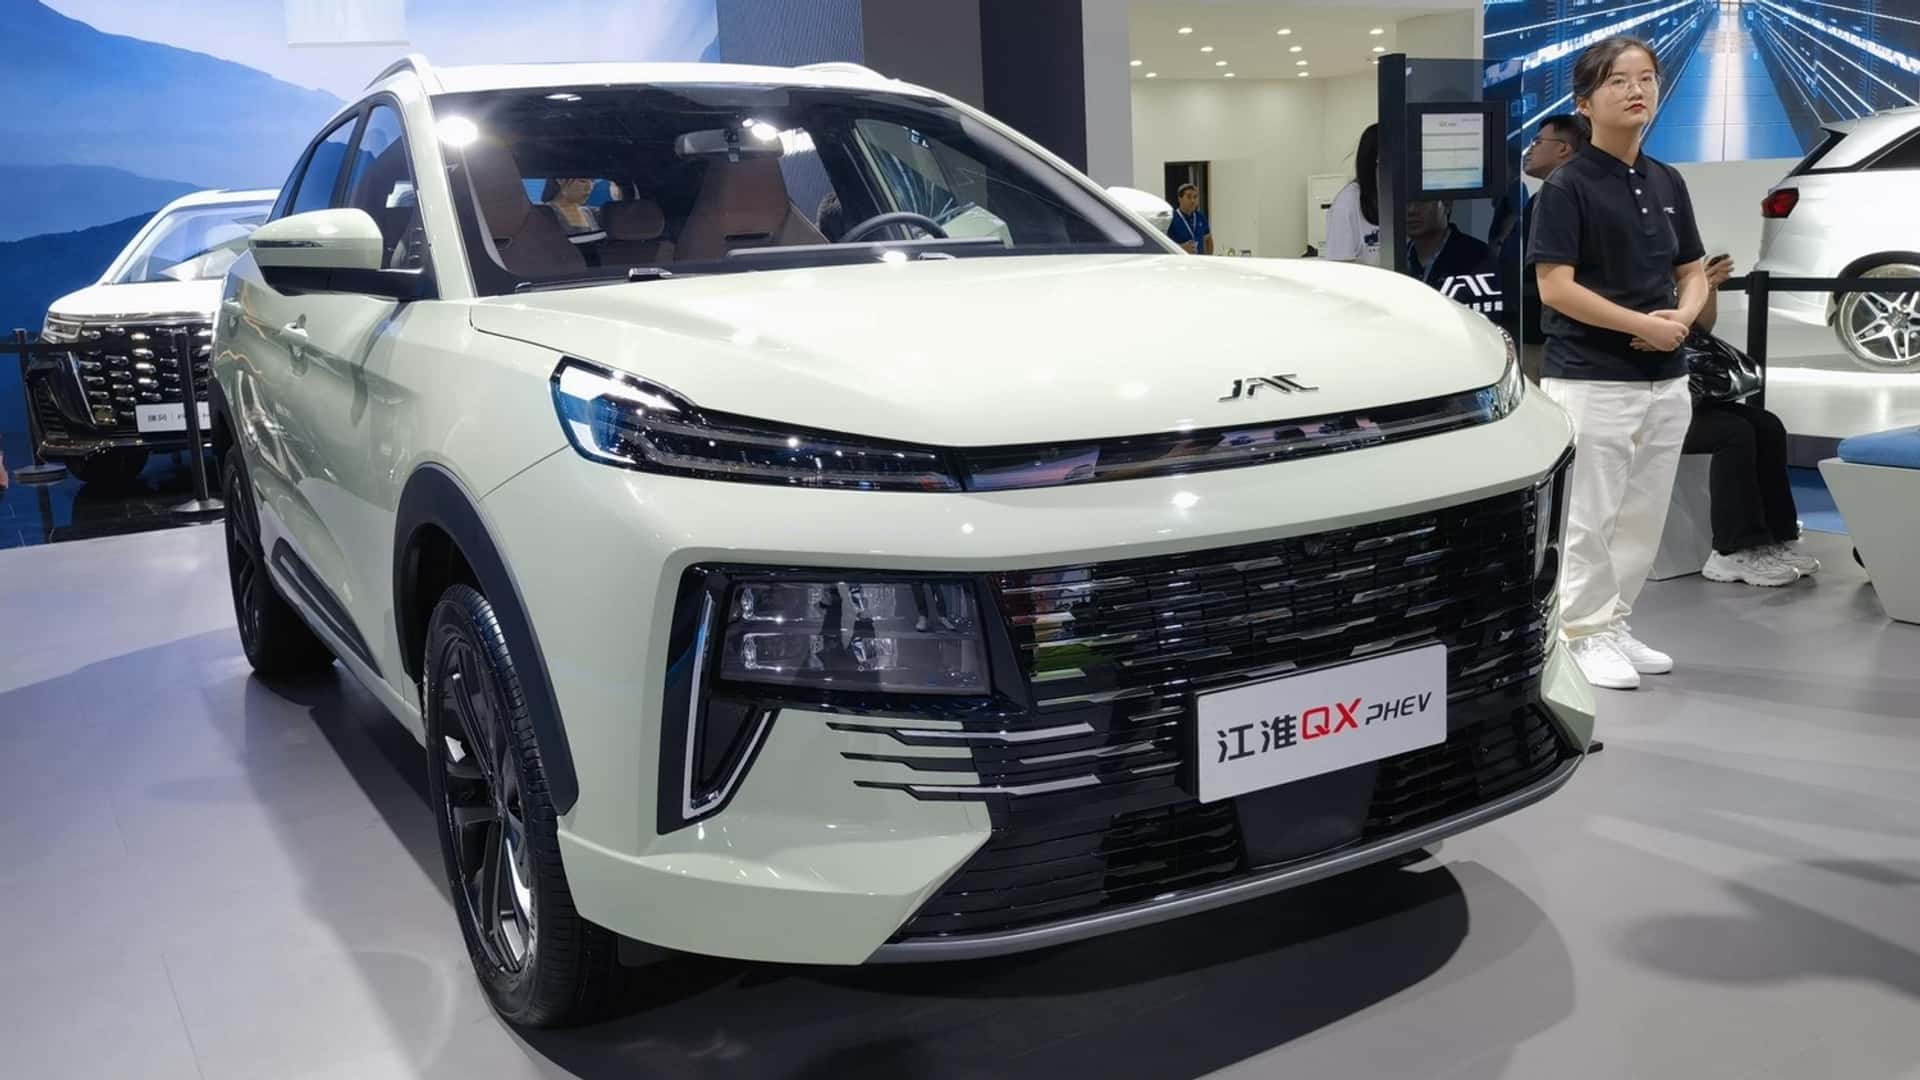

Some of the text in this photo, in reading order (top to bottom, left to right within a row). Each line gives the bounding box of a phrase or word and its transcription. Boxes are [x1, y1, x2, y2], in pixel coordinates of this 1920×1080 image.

[1218, 374, 1319, 402] JAC
[1216, 714, 1297, 764] 江淮
[1365, 691, 1432, 725] PHEV
